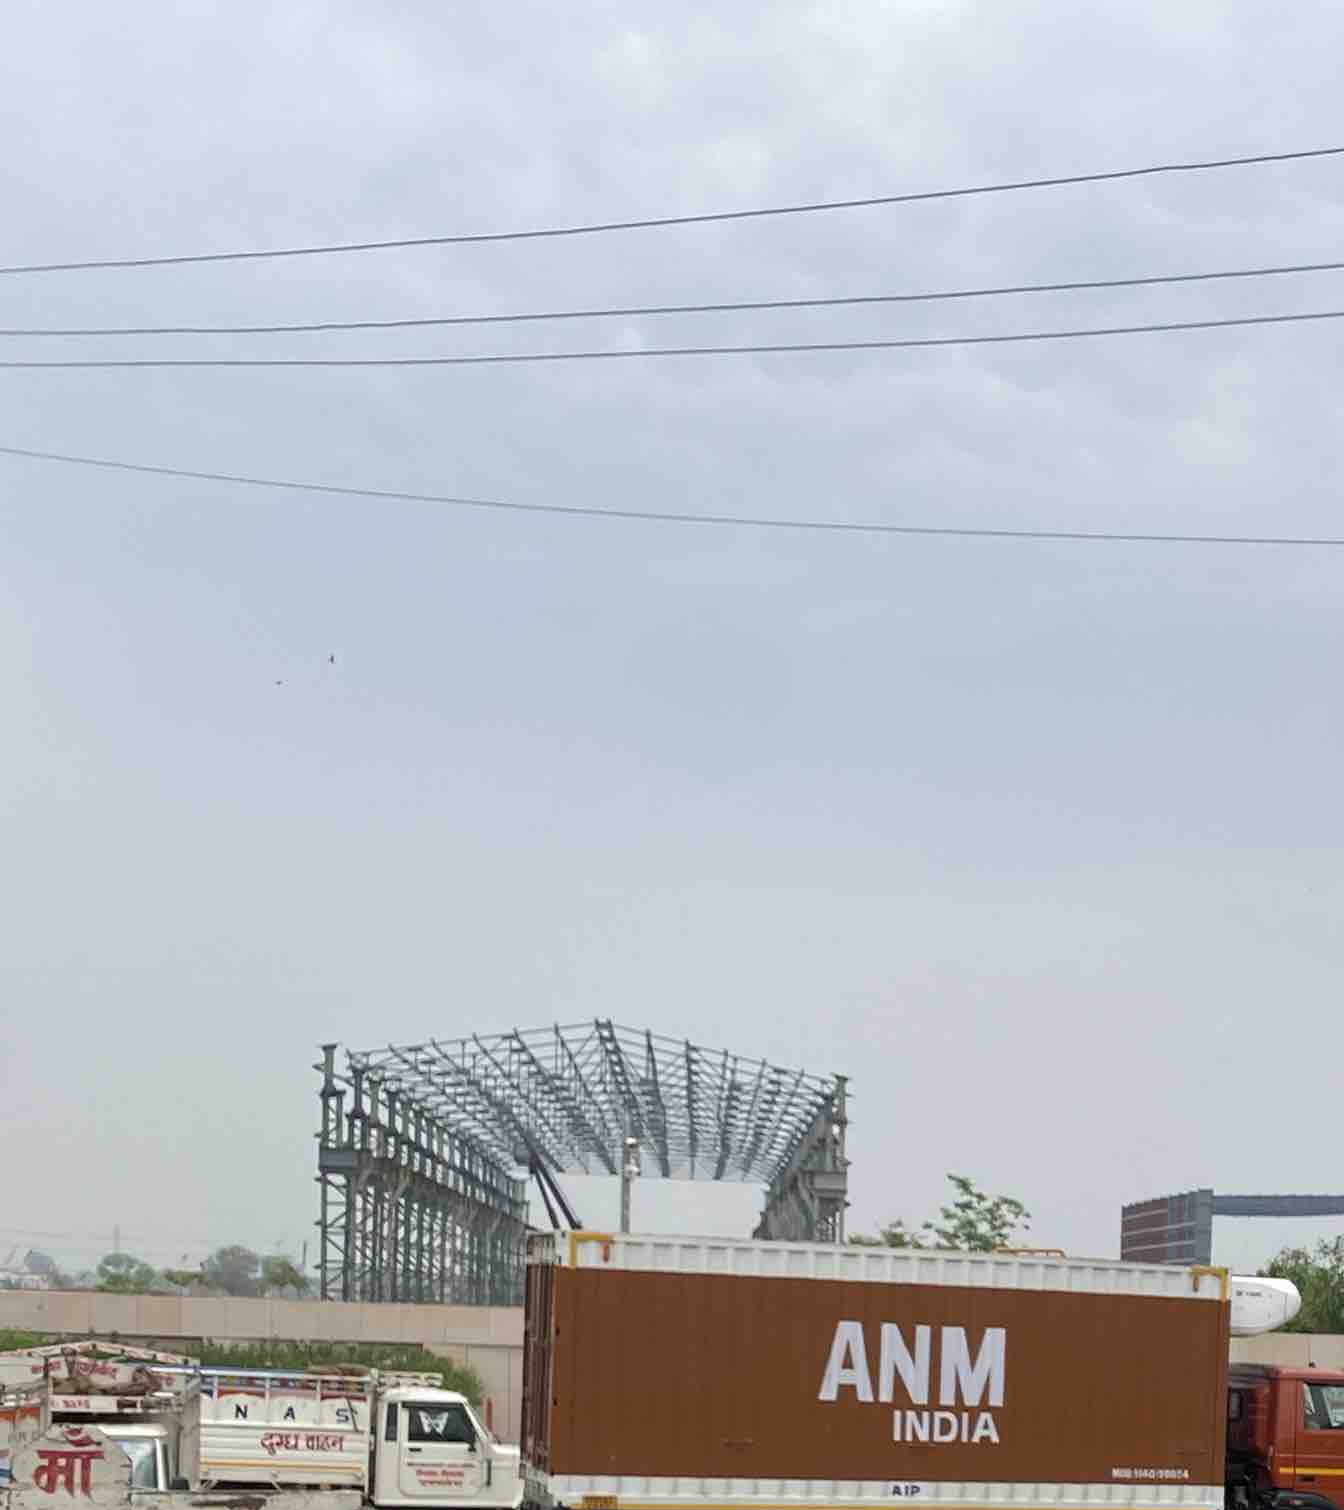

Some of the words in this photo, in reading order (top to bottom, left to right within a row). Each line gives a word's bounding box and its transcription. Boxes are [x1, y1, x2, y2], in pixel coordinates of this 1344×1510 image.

[818, 1320, 1006, 1408] ANM
[892, 1409, 1000, 1444] INDIA
[892, 1485, 920, 1497] AIP
